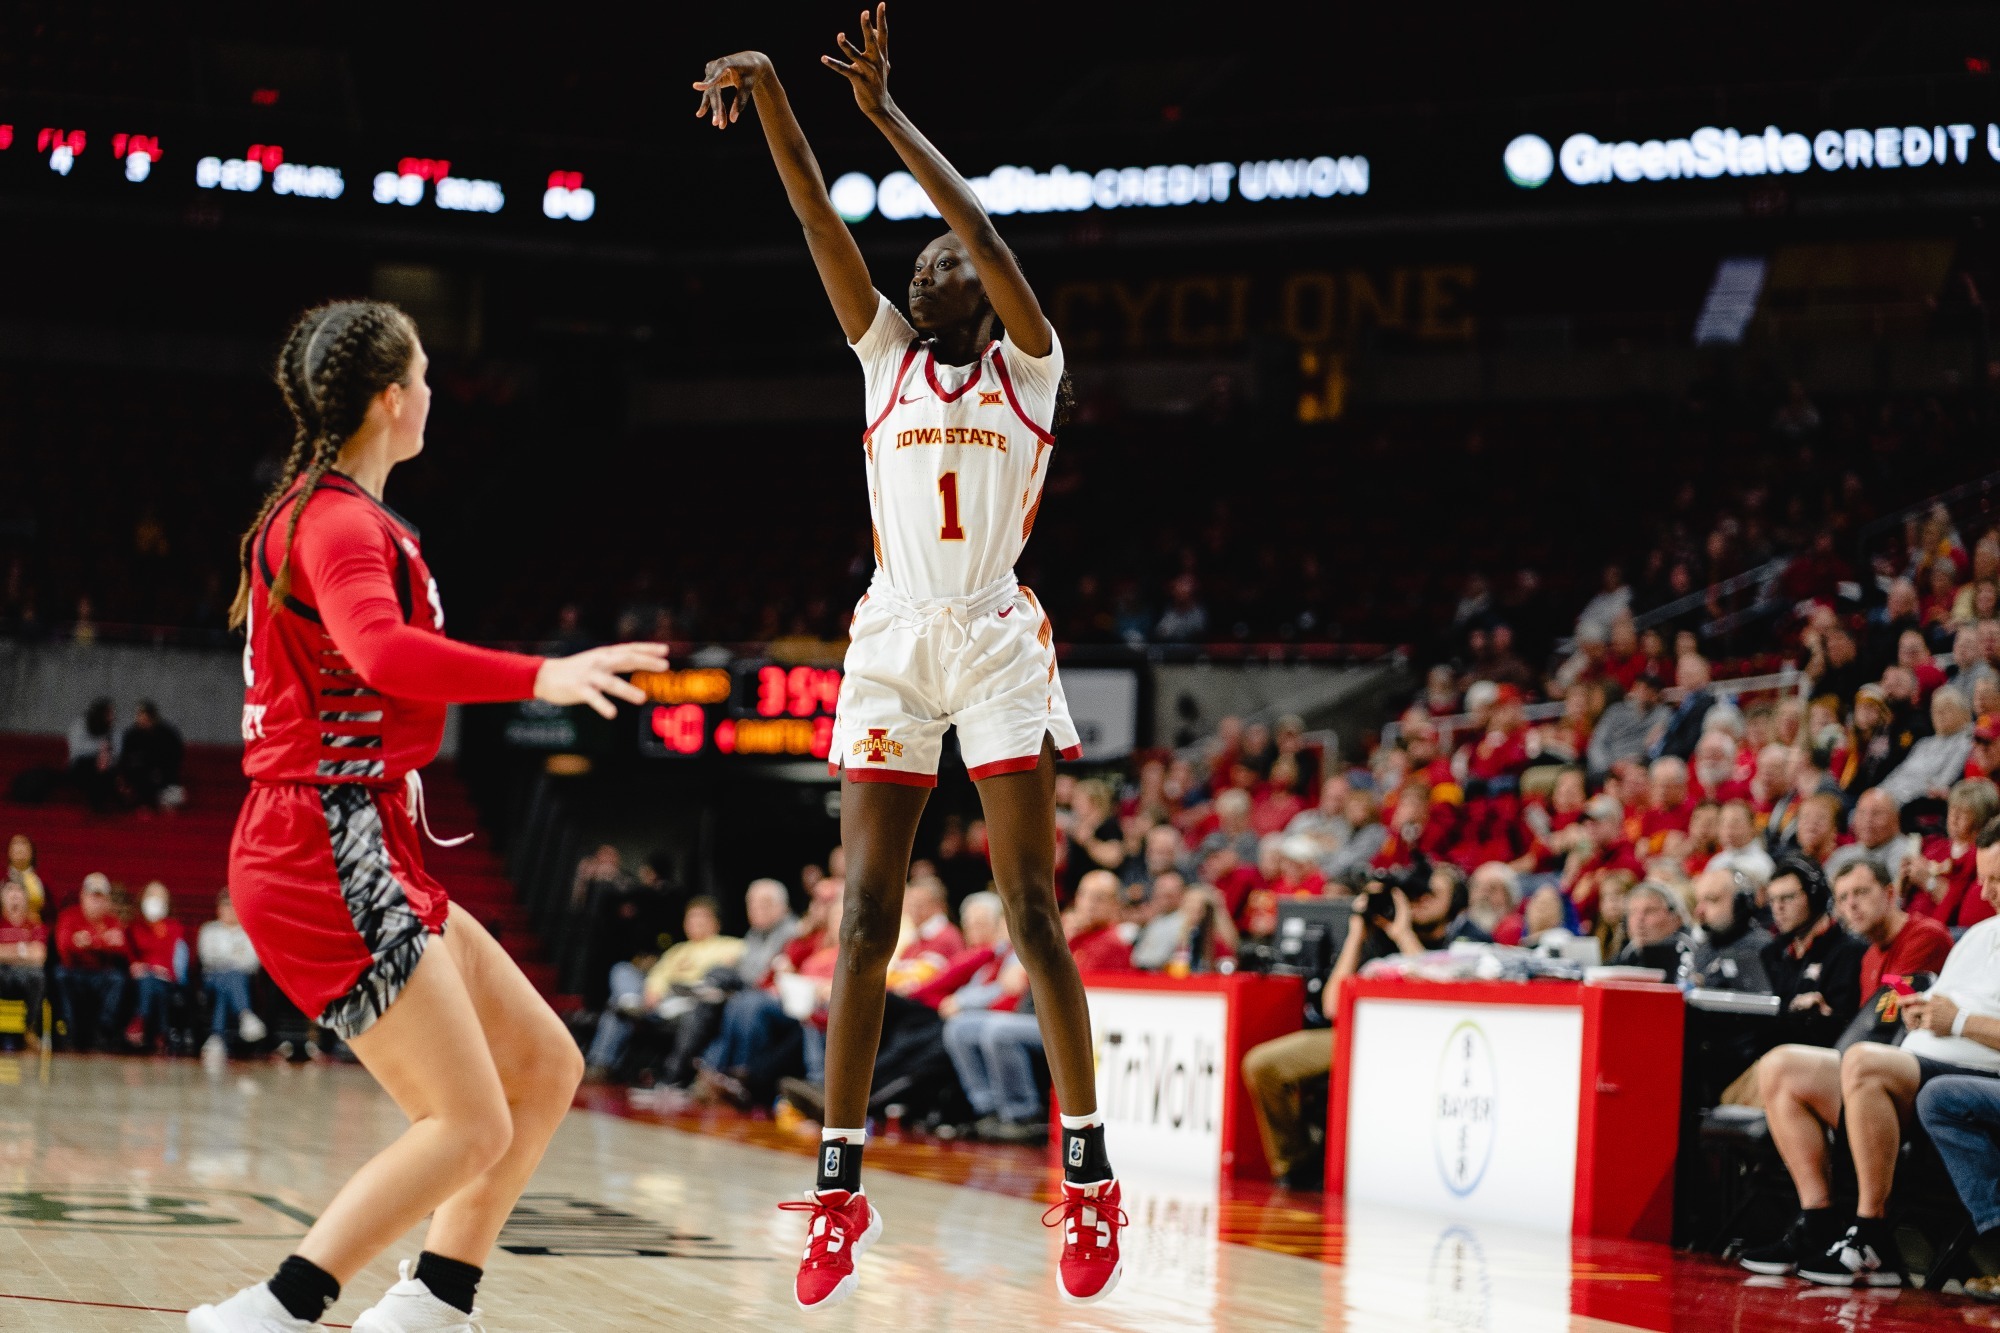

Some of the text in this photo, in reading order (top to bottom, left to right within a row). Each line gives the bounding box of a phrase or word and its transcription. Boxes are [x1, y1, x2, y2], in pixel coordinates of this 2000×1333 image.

[1560, 125, 1811, 185] GreenState
[1813, 123, 1976, 172] CREDIT
[1094, 162, 1236, 209] CREDIT
[1239, 155, 1370, 201] UNION
[896, 427, 1007, 453] IOWA STATE
[938, 470, 966, 542] 1
[852, 739, 904, 758] STATE
[1440, 1094, 1492, 1122] BAYER
